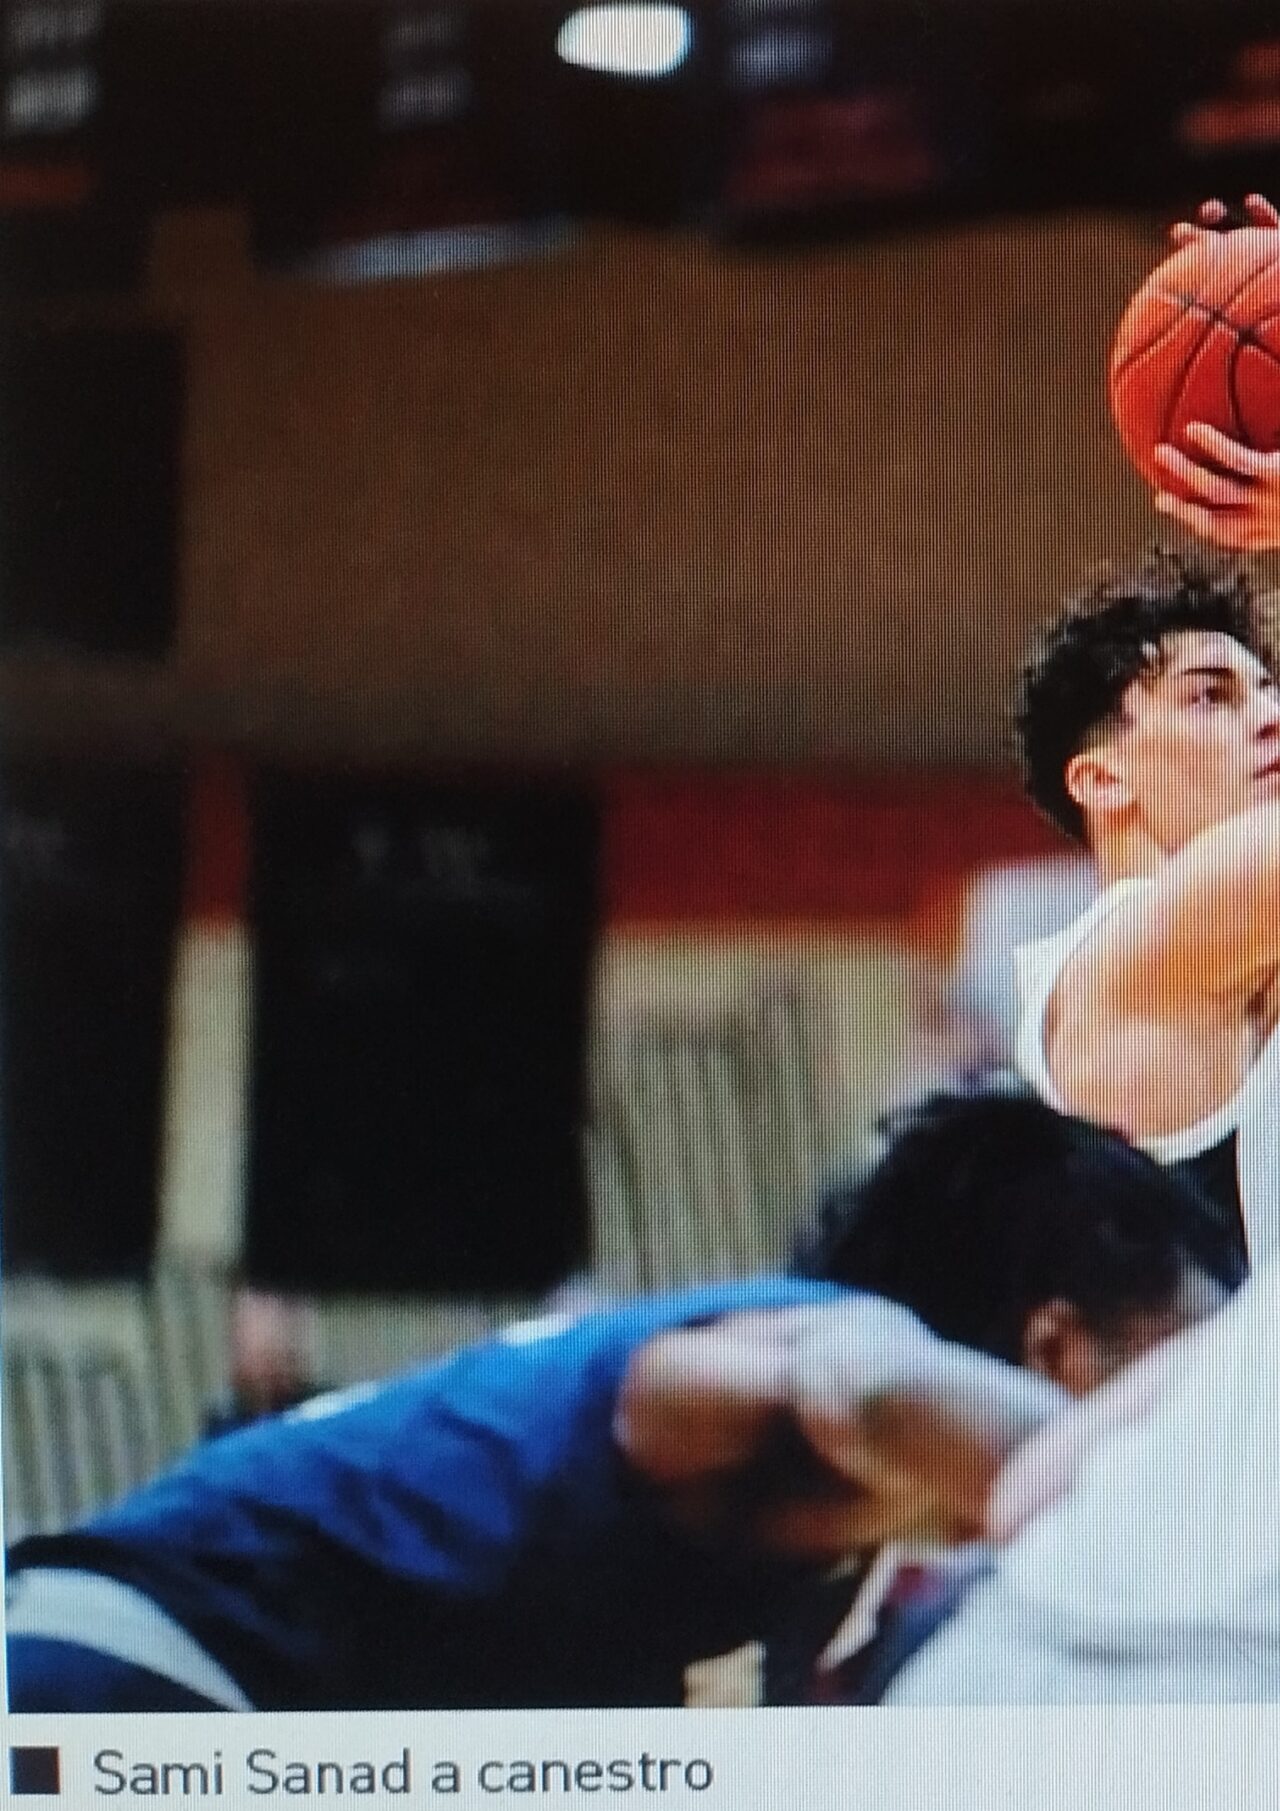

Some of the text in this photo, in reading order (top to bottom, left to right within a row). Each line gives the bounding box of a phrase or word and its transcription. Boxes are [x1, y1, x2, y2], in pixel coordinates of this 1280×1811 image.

[92, 1747, 714, 1797] Sami Sanad a canestro
